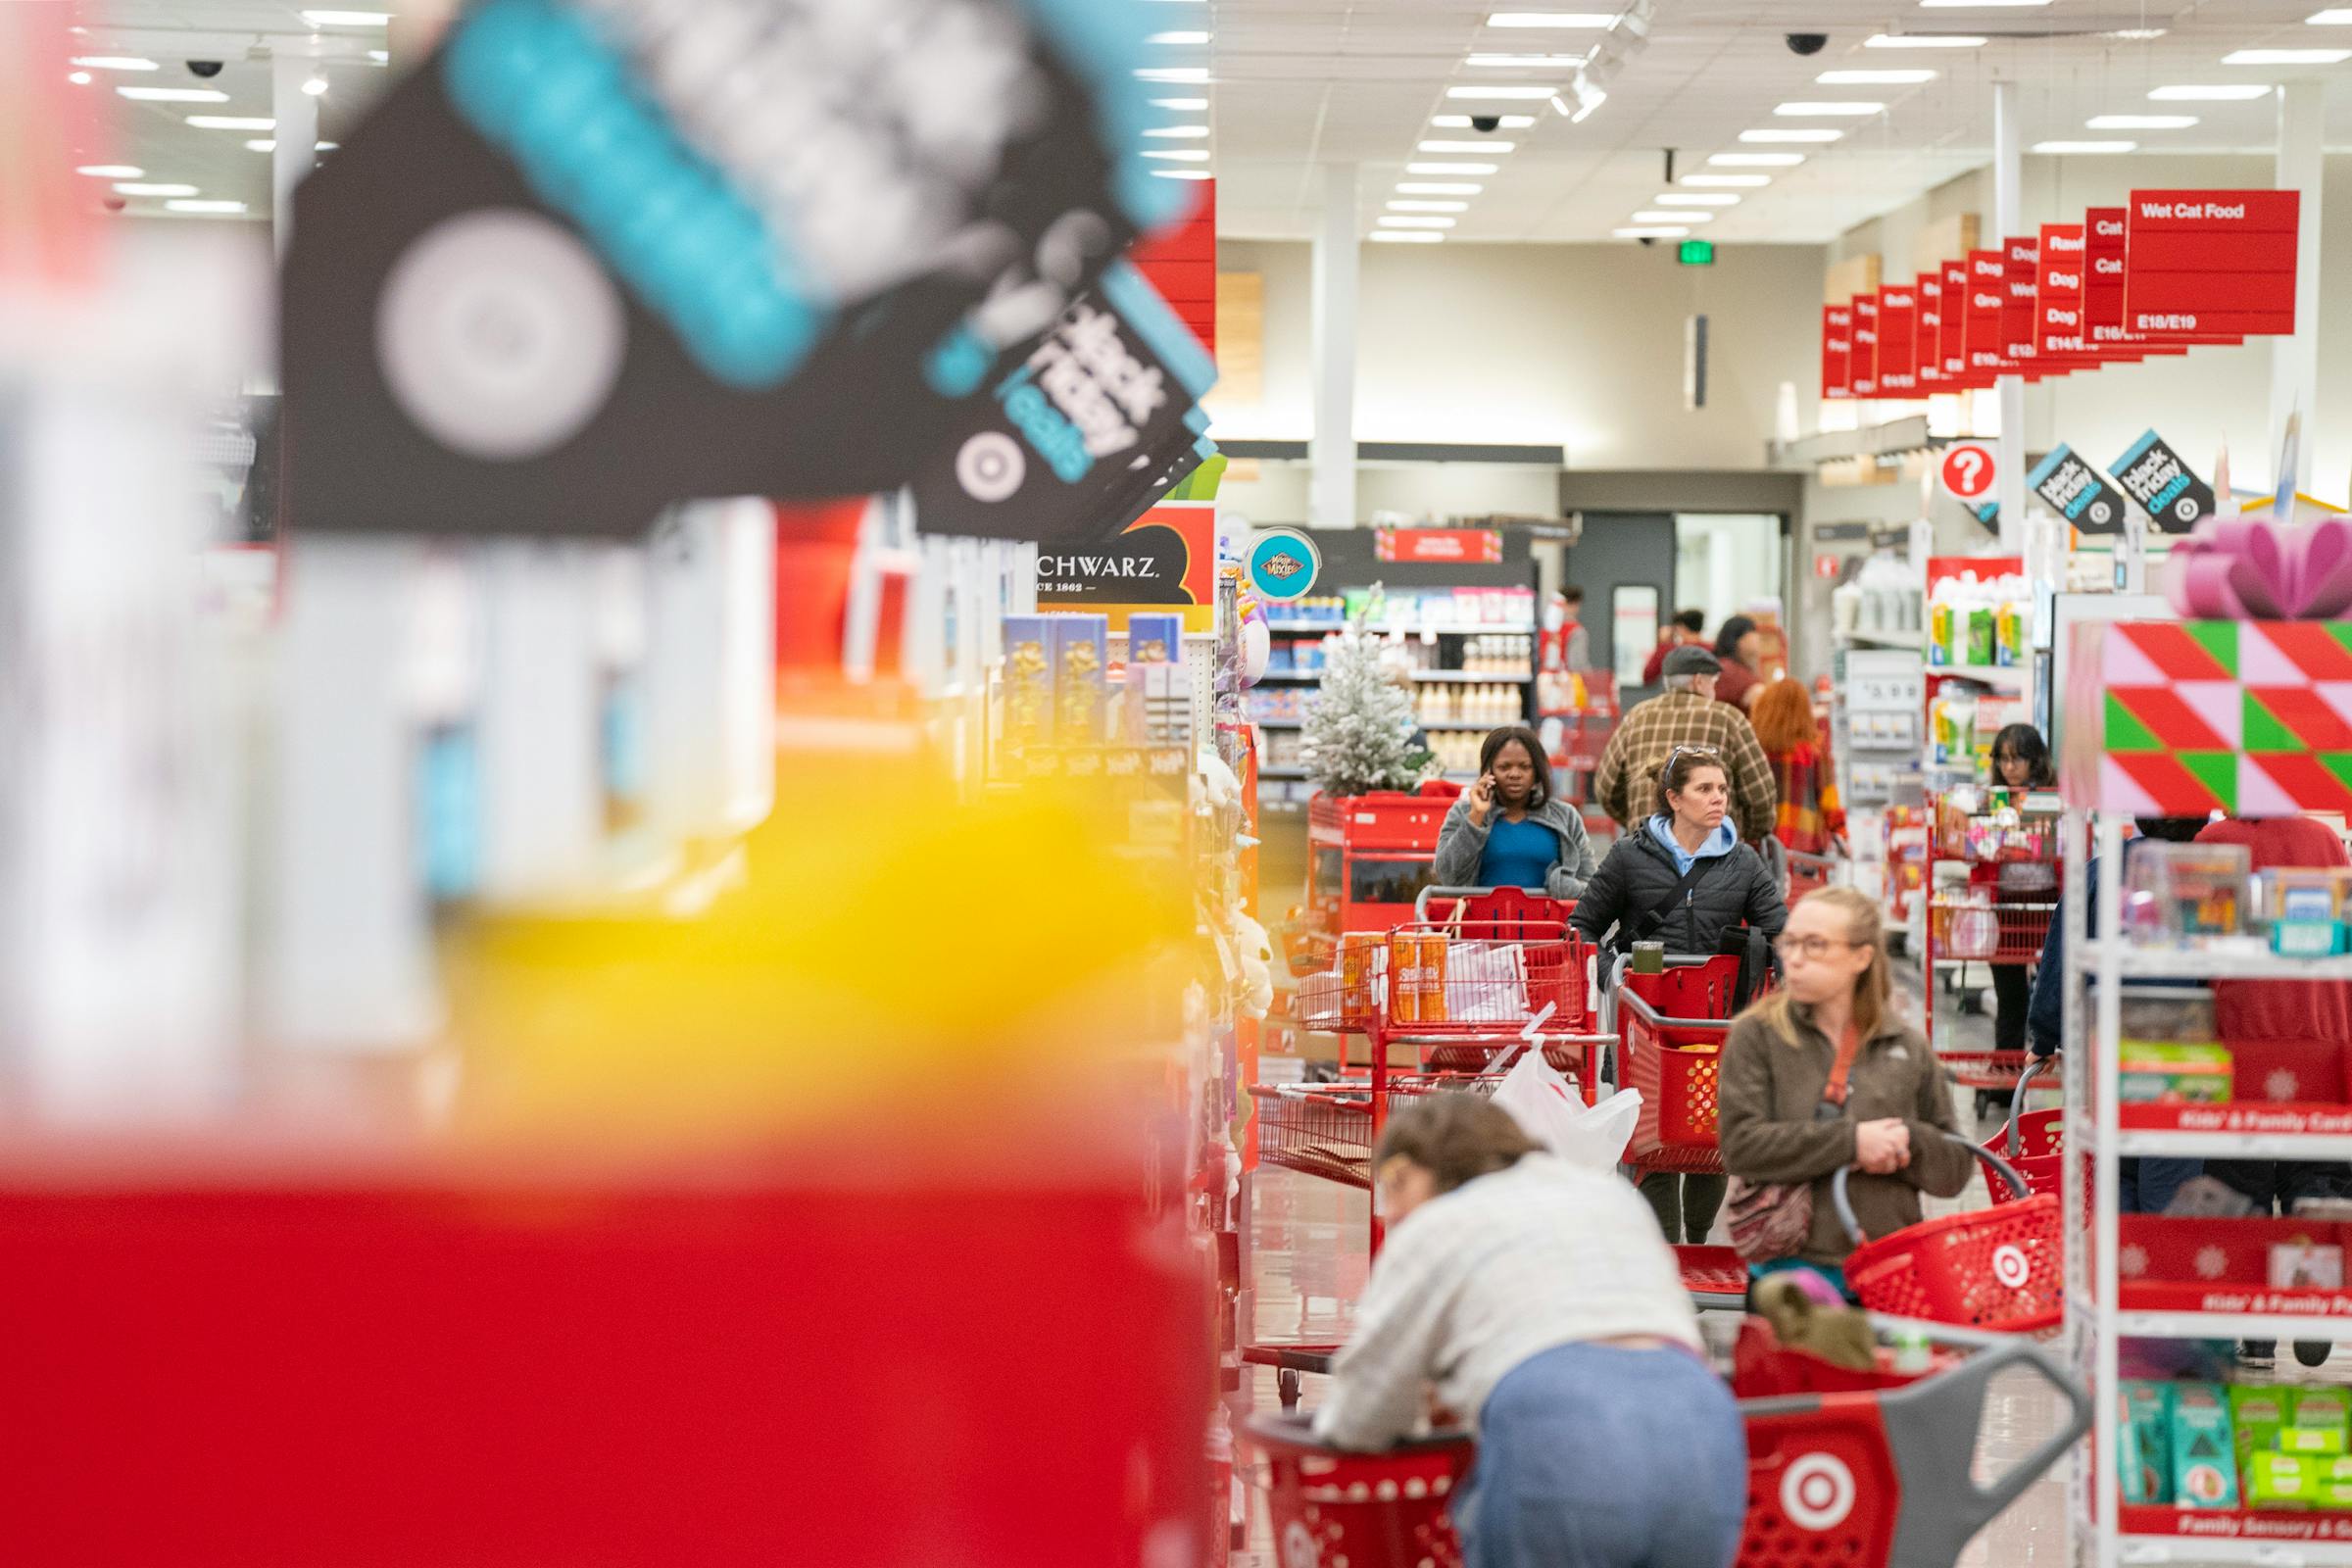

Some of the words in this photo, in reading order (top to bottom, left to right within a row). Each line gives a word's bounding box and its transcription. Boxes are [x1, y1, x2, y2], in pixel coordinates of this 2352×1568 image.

[2140, 203, 2172, 218] Wet
[2174, 203, 2202, 218] Cat
[2205, 203, 2245, 218] Food
[2095, 220, 2124, 235] Cat
[2094, 258, 2123, 273] Cat
[2048, 271, 2079, 289] Dog
[2046, 308, 2078, 325] Dog
[2136, 315, 2197, 329] E18/E19
[2122, 448, 2169, 489] black
[2134, 458, 2181, 503] friday
[2148, 472, 2191, 514] deals
[1036, 556, 1160, 578] CHWARZ.
[1055, 582, 1083, 592] 1862
[2243, 1110, 2307, 1132] Family
[2268, 1294, 2331, 1315] Family
[2178, 1515, 2242, 1537] Family
